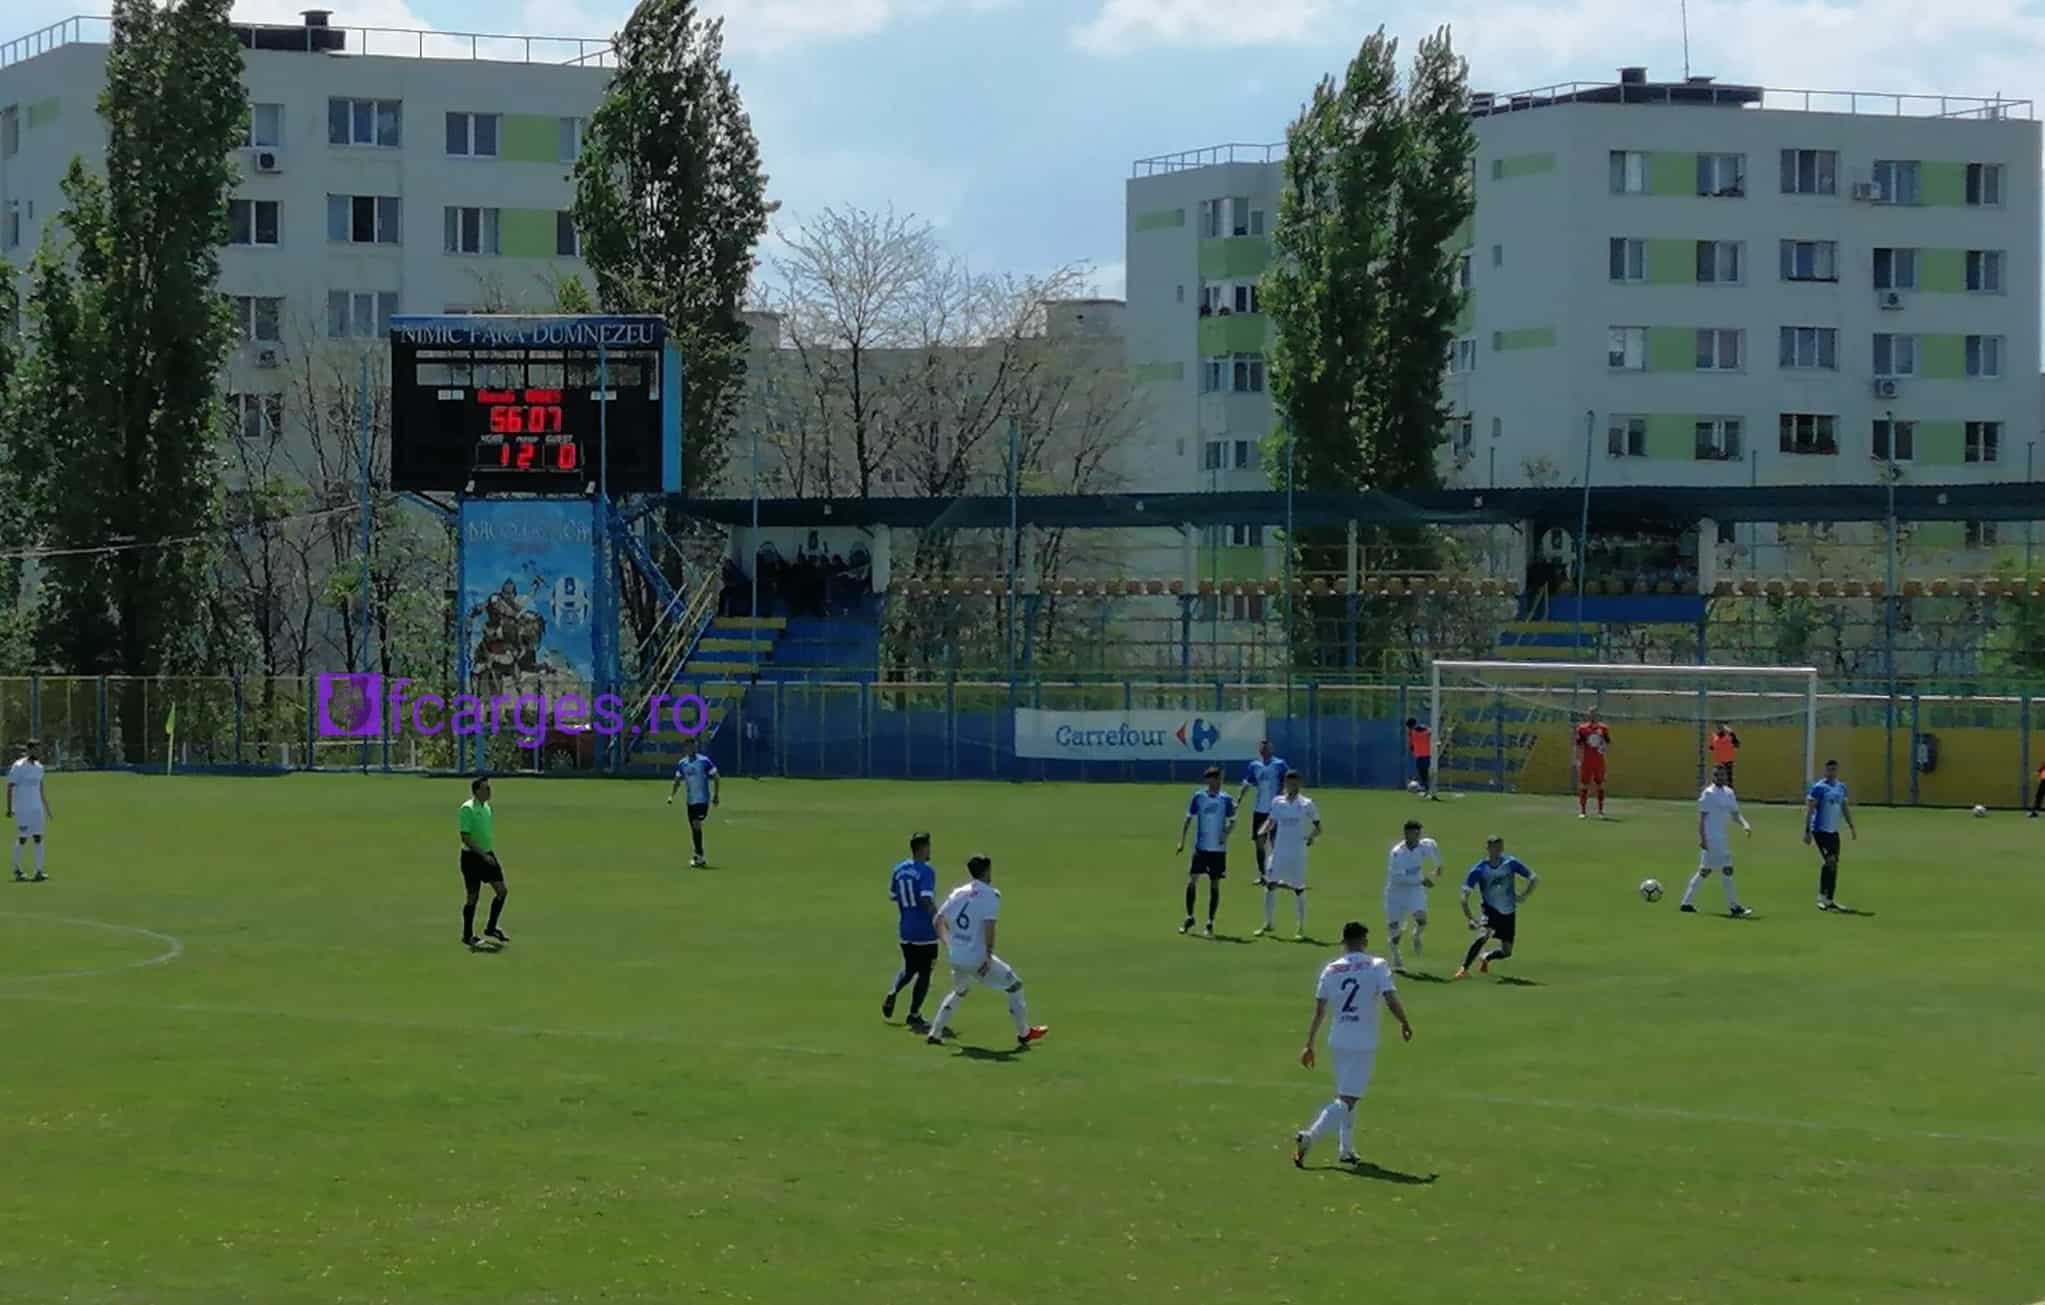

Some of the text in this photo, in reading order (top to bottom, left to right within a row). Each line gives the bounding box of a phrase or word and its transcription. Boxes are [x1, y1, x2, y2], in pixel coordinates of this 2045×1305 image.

[401, 324, 463, 344] NIMIC
[532, 323, 654, 344] DUMNEZEU
[1055, 722, 1167, 746] Carrefour
[898, 879, 917, 908] 11
[956, 901, 970, 930] 6
[1341, 977, 1360, 1012] 2
